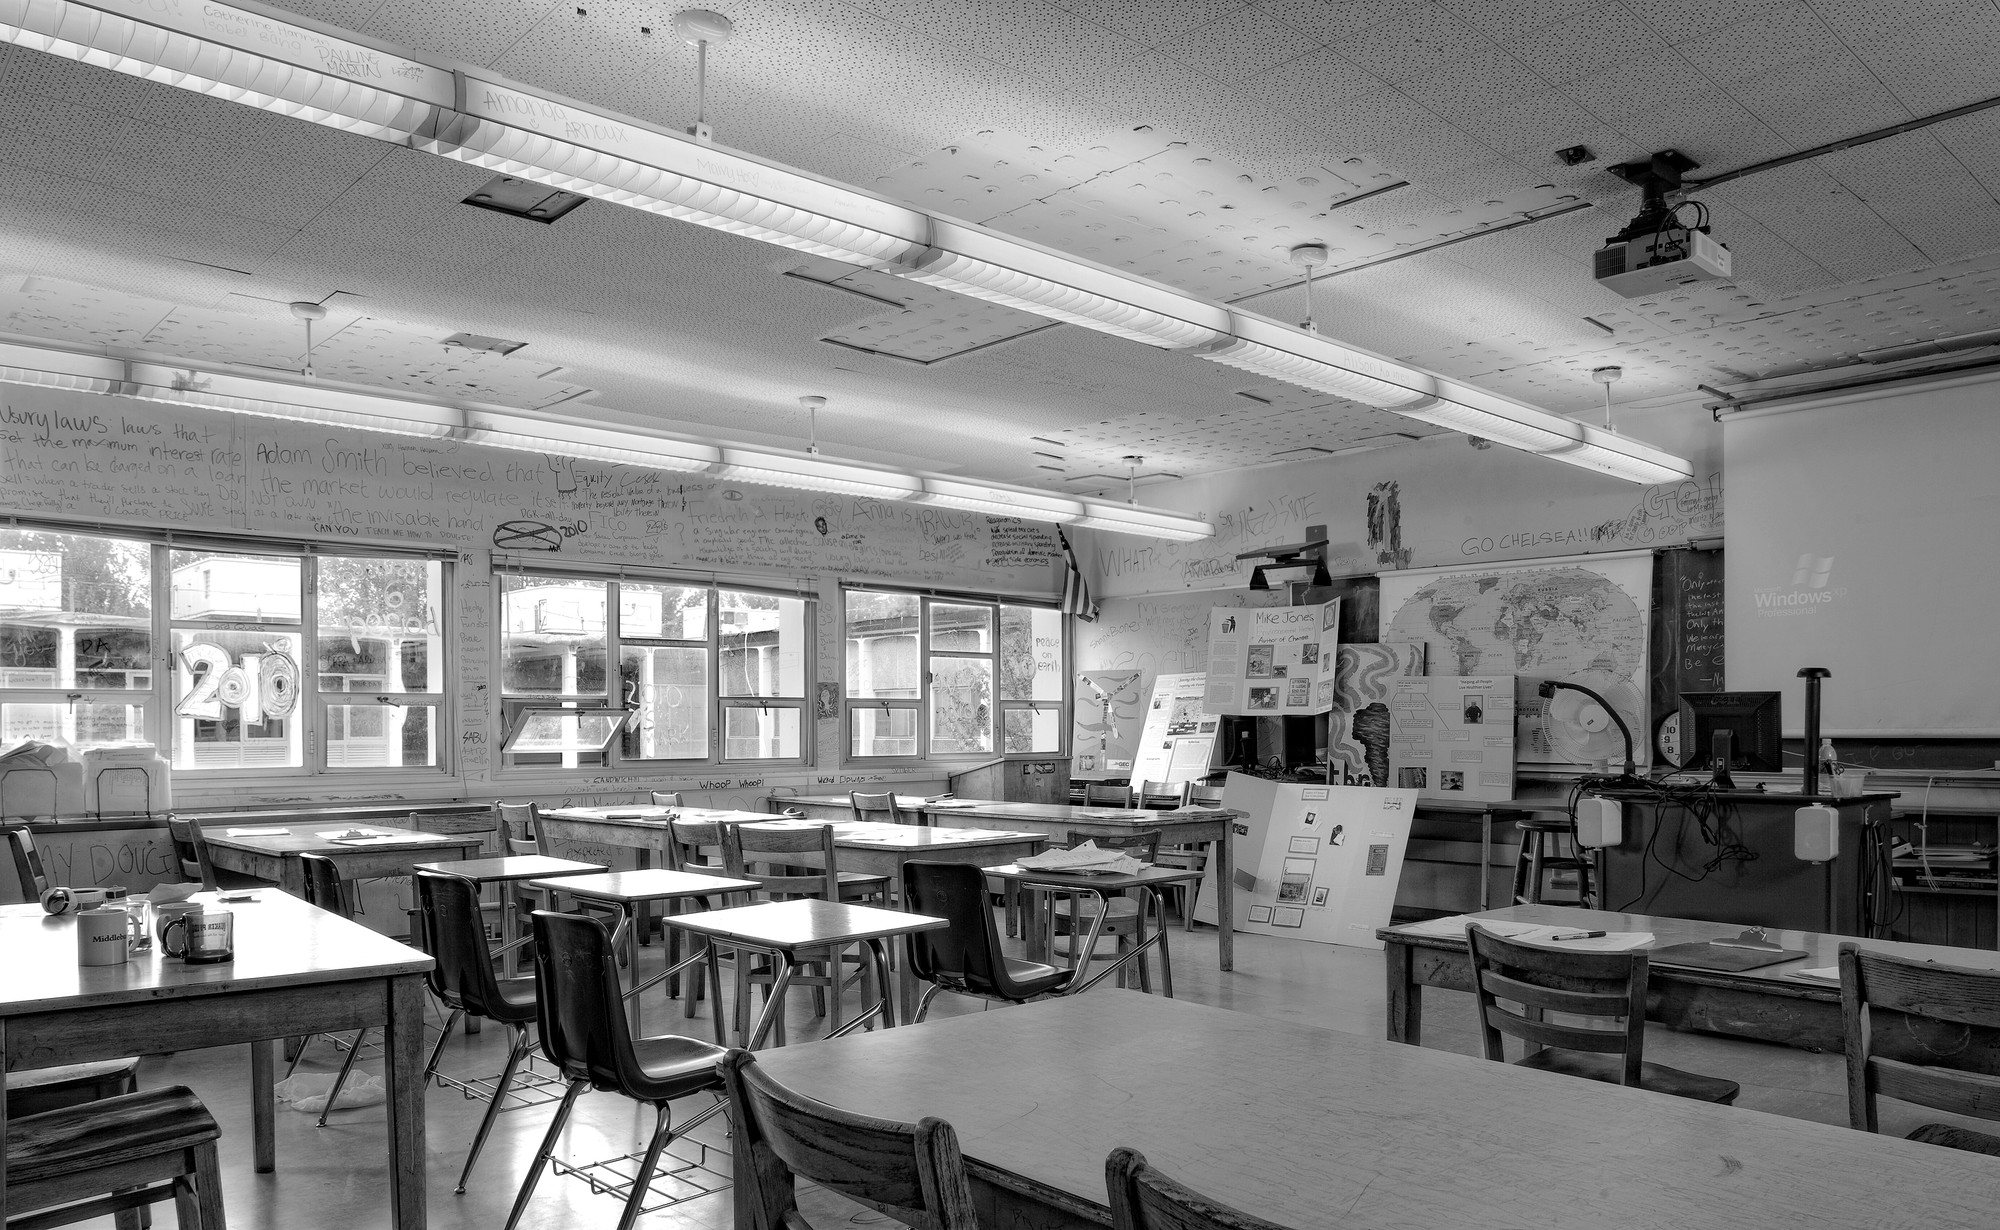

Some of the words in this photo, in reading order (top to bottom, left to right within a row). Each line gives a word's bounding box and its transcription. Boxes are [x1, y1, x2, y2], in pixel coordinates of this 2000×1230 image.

[203, 5, 273, 33] Catherine
[484, 91, 567, 122] Amanda
[121, 416, 161, 435] laws
[173, 424, 216, 444] that
[33, 432, 68, 448] the
[211, 441, 241, 467] rate
[4, 447, 43, 471] that
[51, 459, 80, 473] can
[158, 464, 176, 478] on
[184, 466, 199, 479] a
[257, 442, 312, 464] Adam
[322, 438, 387, 476] Smith
[402, 452, 494, 481] believed
[506, 461, 544, 484] that
[69, 480, 80, 488] a
[576, 469, 613, 488] Equity
[260, 467, 293, 494] the
[303, 479, 369, 498] market
[379, 482, 433, 500] would
[446, 484, 520, 515] regulate
[852, 501, 896, 522] Anna
[314, 522, 332, 533] CAN
[334, 524, 358, 535] YOU
[365, 527, 389, 535] TEACH
[560, 519, 588, 538] 2010
[1461, 537, 1494, 556] GO
[1100, 547, 1153, 576] WHAT?
[1755, 591, 1832, 608] Windows
[1256, 612, 1279, 625] Mike
[1282, 611, 1314, 623] Jones
[1758, 606, 1817, 617] Professional
[463, 731, 487, 744] SABU
[1666, 726, 1676, 734] 10
[1667, 746, 1674, 754] 8
[1675, 753, 1680, 761] 7
